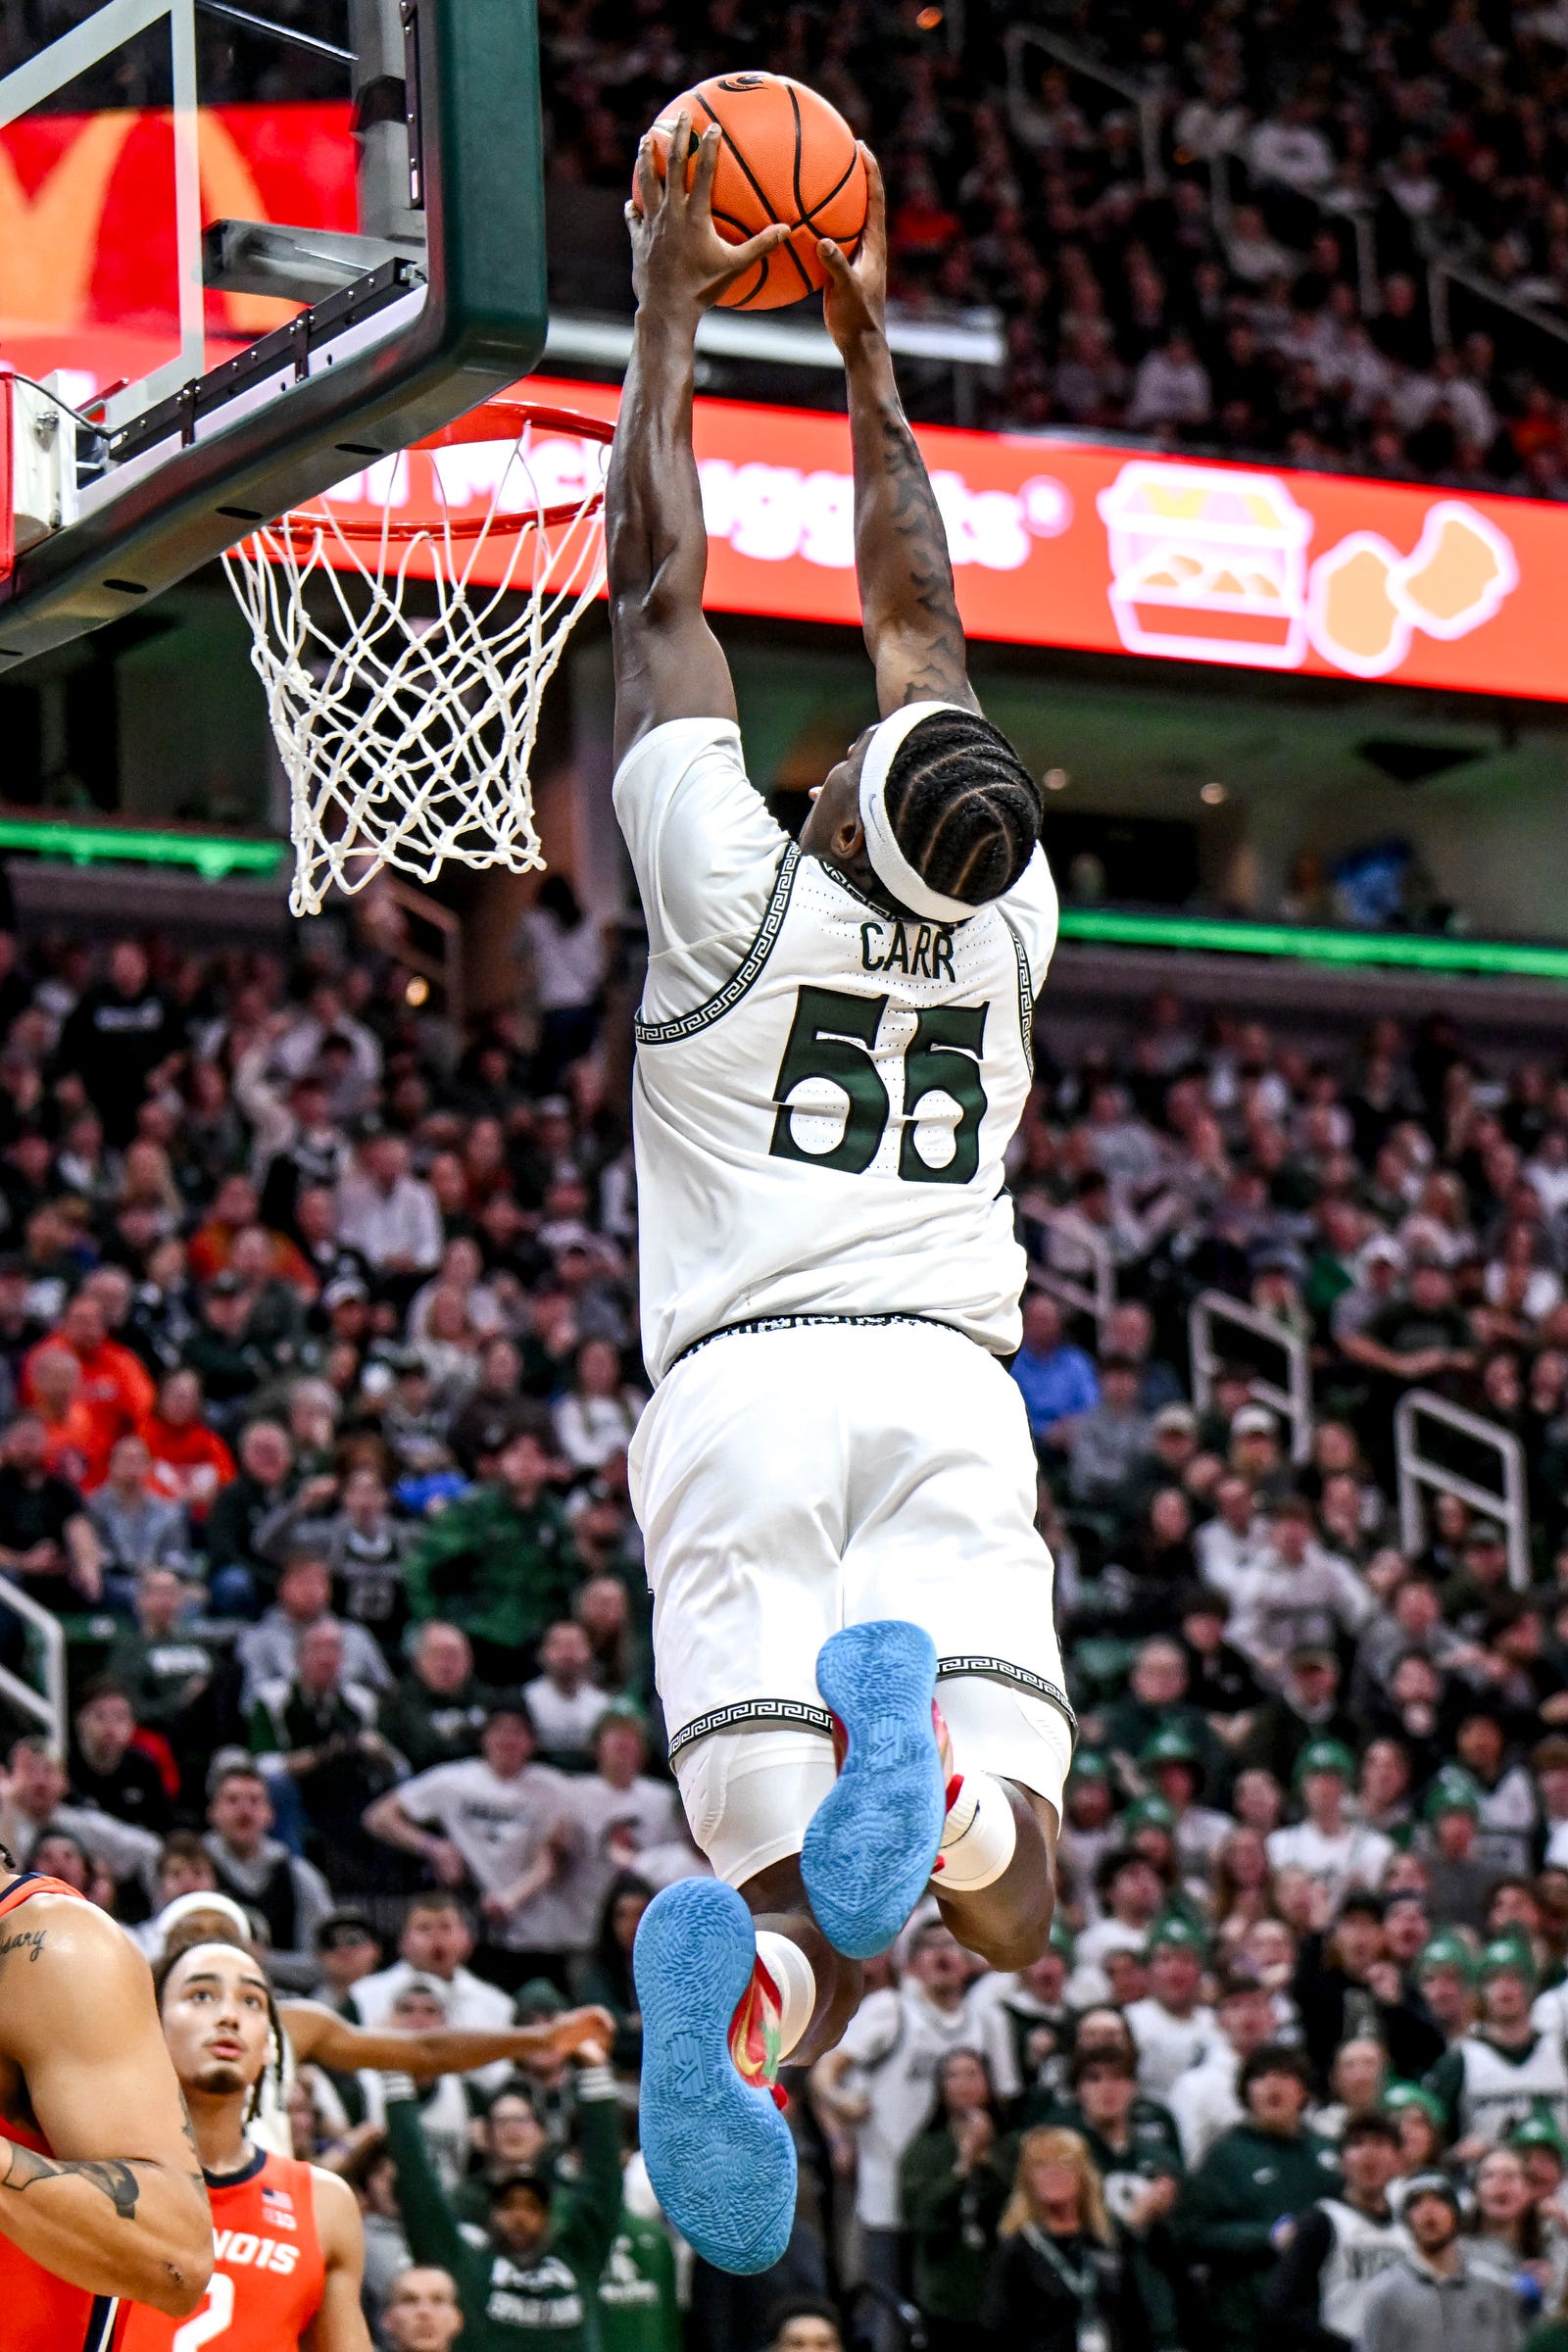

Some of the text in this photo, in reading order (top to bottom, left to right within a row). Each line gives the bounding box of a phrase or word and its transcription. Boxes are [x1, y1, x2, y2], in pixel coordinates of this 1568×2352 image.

[859, 920, 956, 984] CARR
[768, 984, 991, 1185] 55
[212, 2228, 301, 2276] NOIS
[172, 2272, 235, 2352] 2
